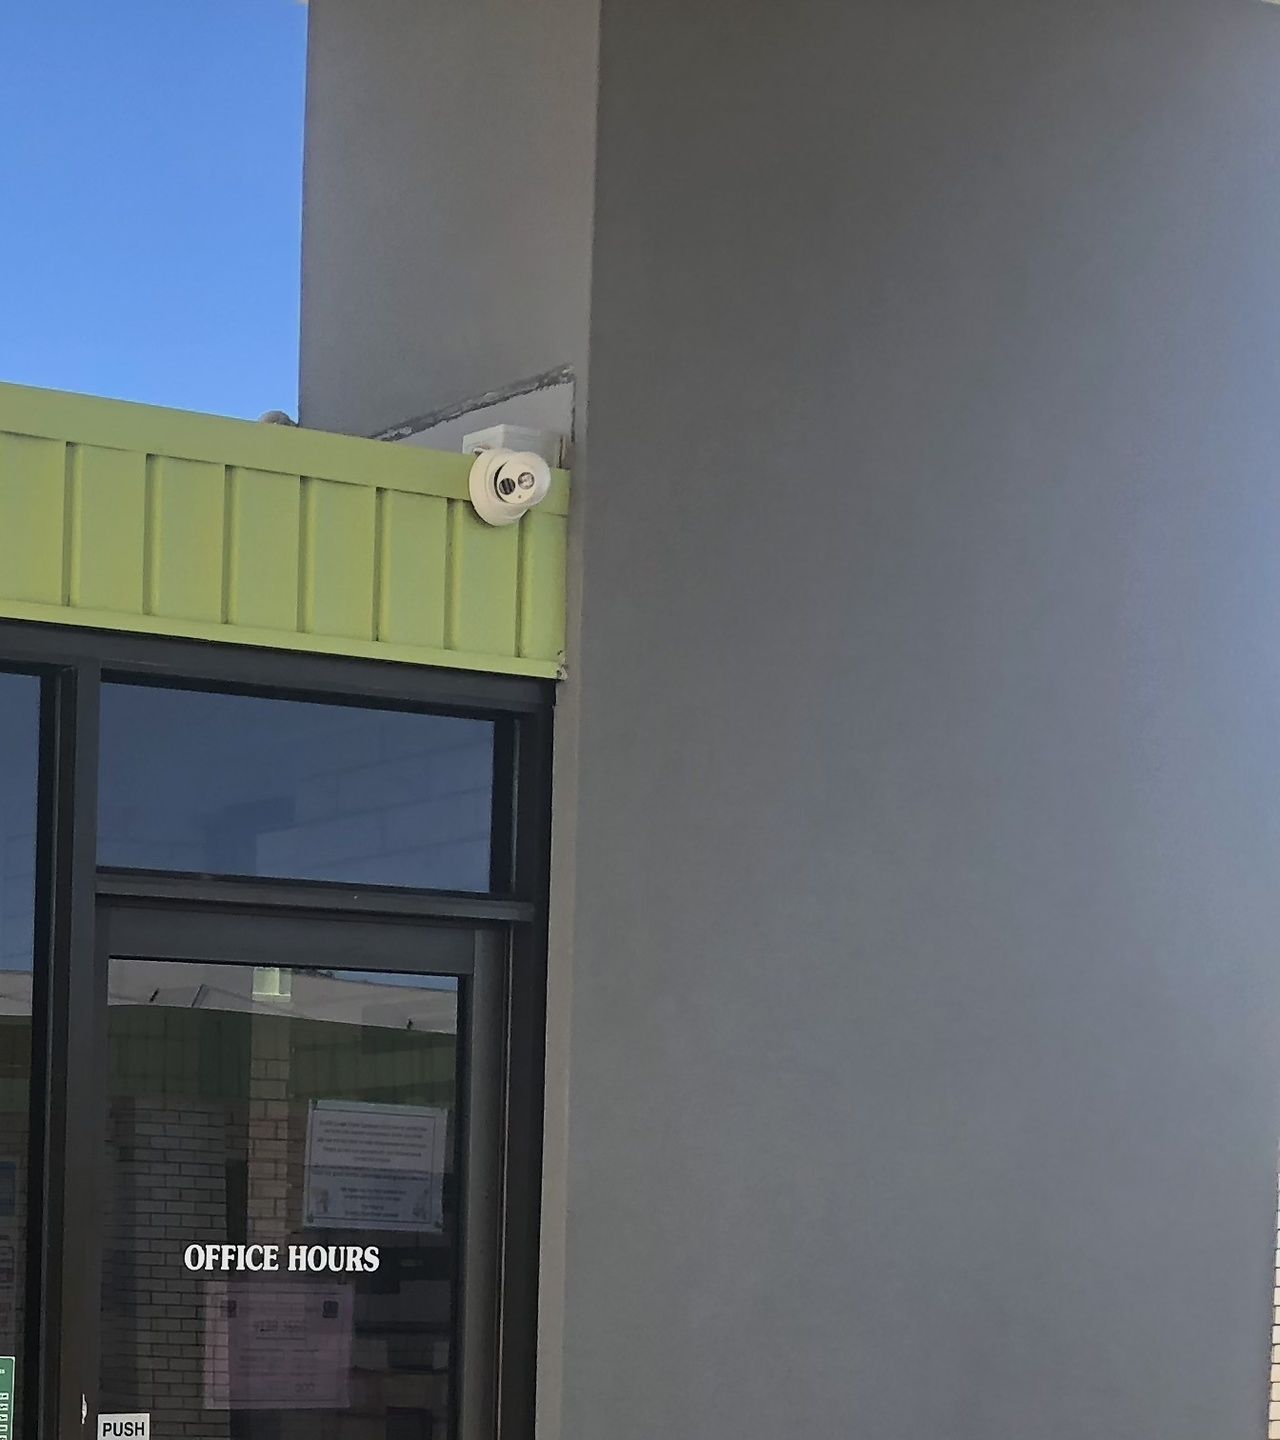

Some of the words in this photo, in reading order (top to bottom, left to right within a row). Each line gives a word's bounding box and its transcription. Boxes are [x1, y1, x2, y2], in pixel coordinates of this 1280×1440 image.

[184, 1243, 279, 1272] OFFICE
[287, 1245, 380, 1273] HOURS
[102, 1421, 145, 1438] PUSH
